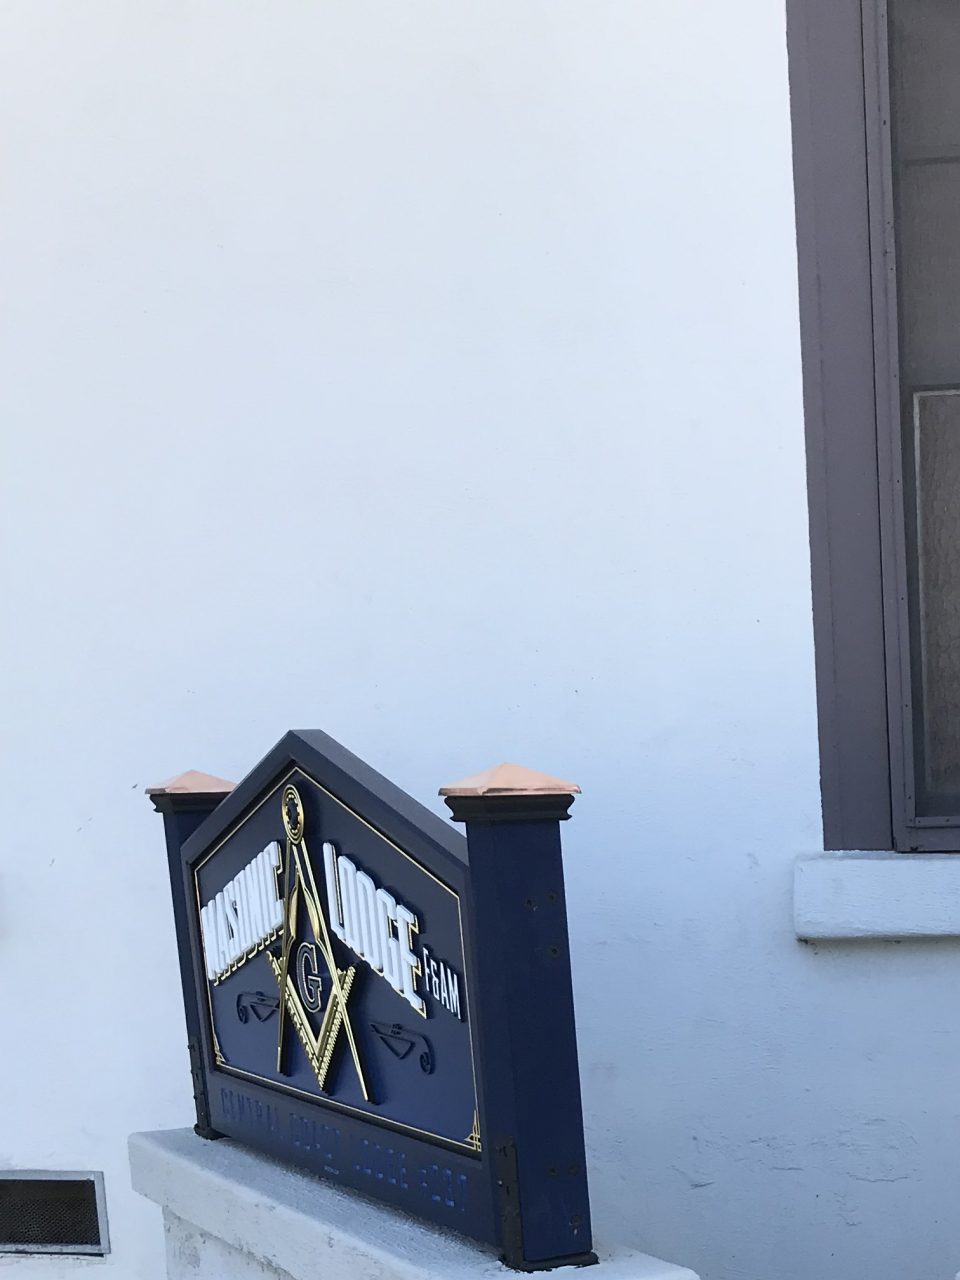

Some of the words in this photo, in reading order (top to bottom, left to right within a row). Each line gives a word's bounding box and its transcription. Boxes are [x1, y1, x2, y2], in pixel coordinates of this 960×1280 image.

[296, 941, 322, 1013] G
[323, 842, 428, 1020] LODGE
[422, 946, 462, 1021] F&AM
